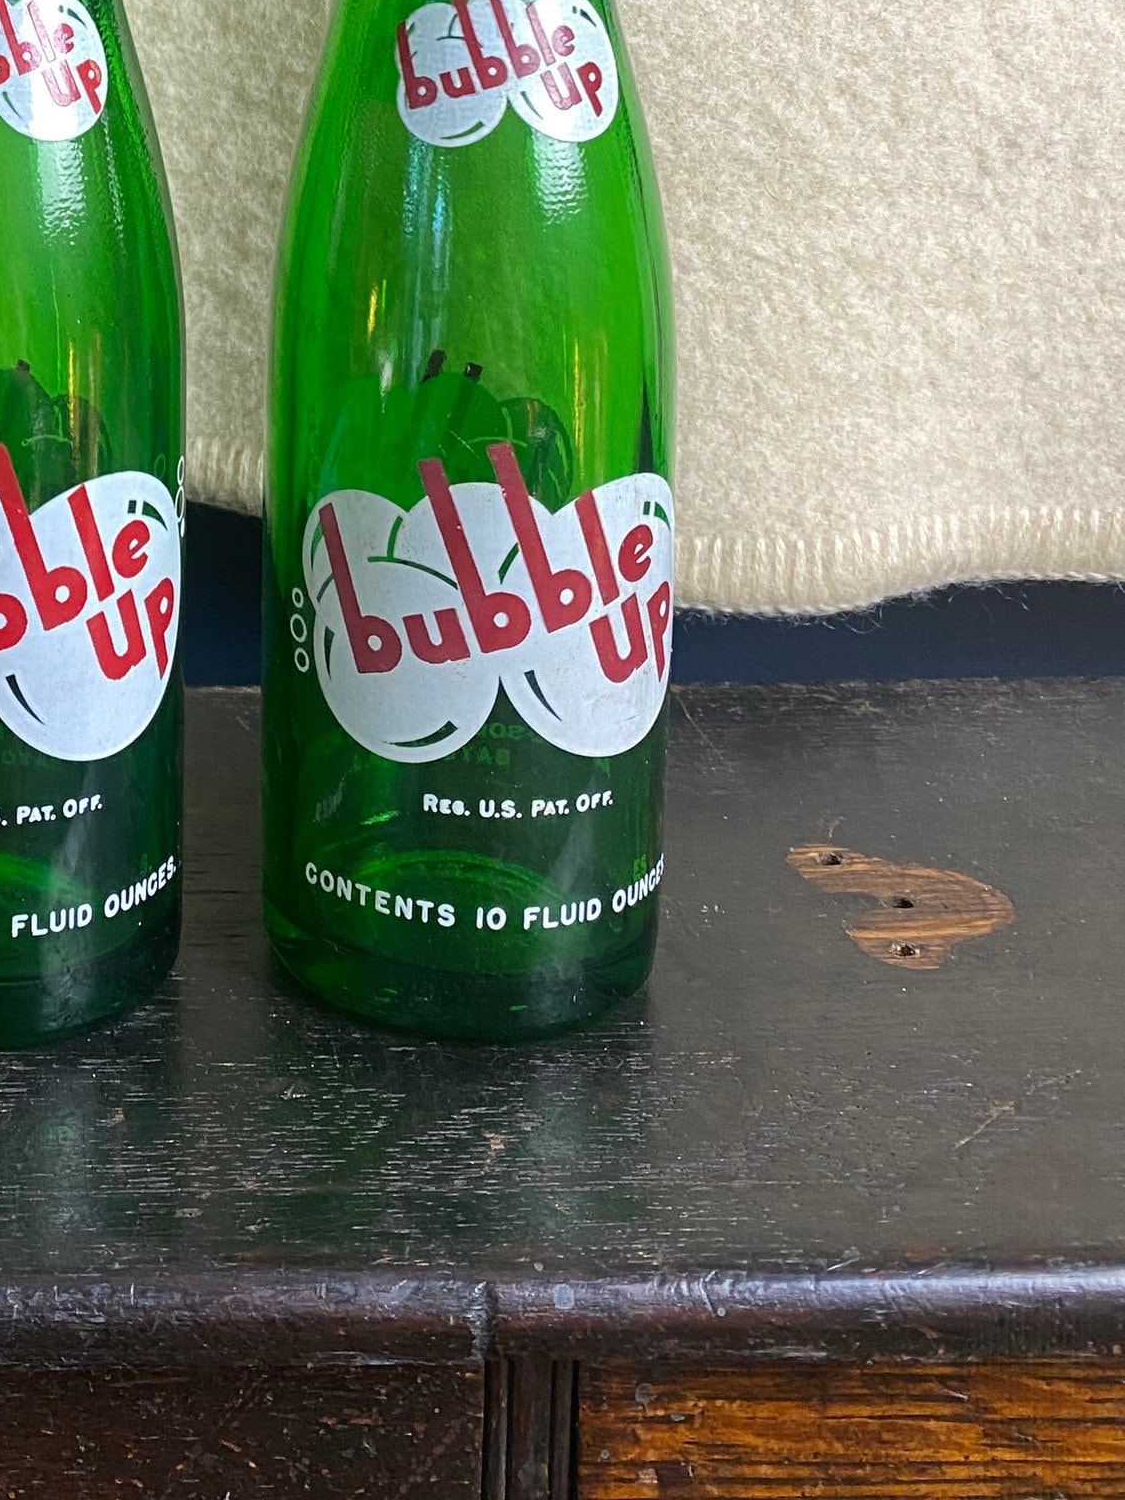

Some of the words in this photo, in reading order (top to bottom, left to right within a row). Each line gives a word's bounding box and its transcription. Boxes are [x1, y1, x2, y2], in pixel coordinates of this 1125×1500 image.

[318, 442, 654, 674] bubble
[479, 799, 522, 818] U.S.
[11, 904, 93, 938] FLUID
[305, 862, 455, 927] CONTENTS
[523, 900, 602, 930] FLUID
